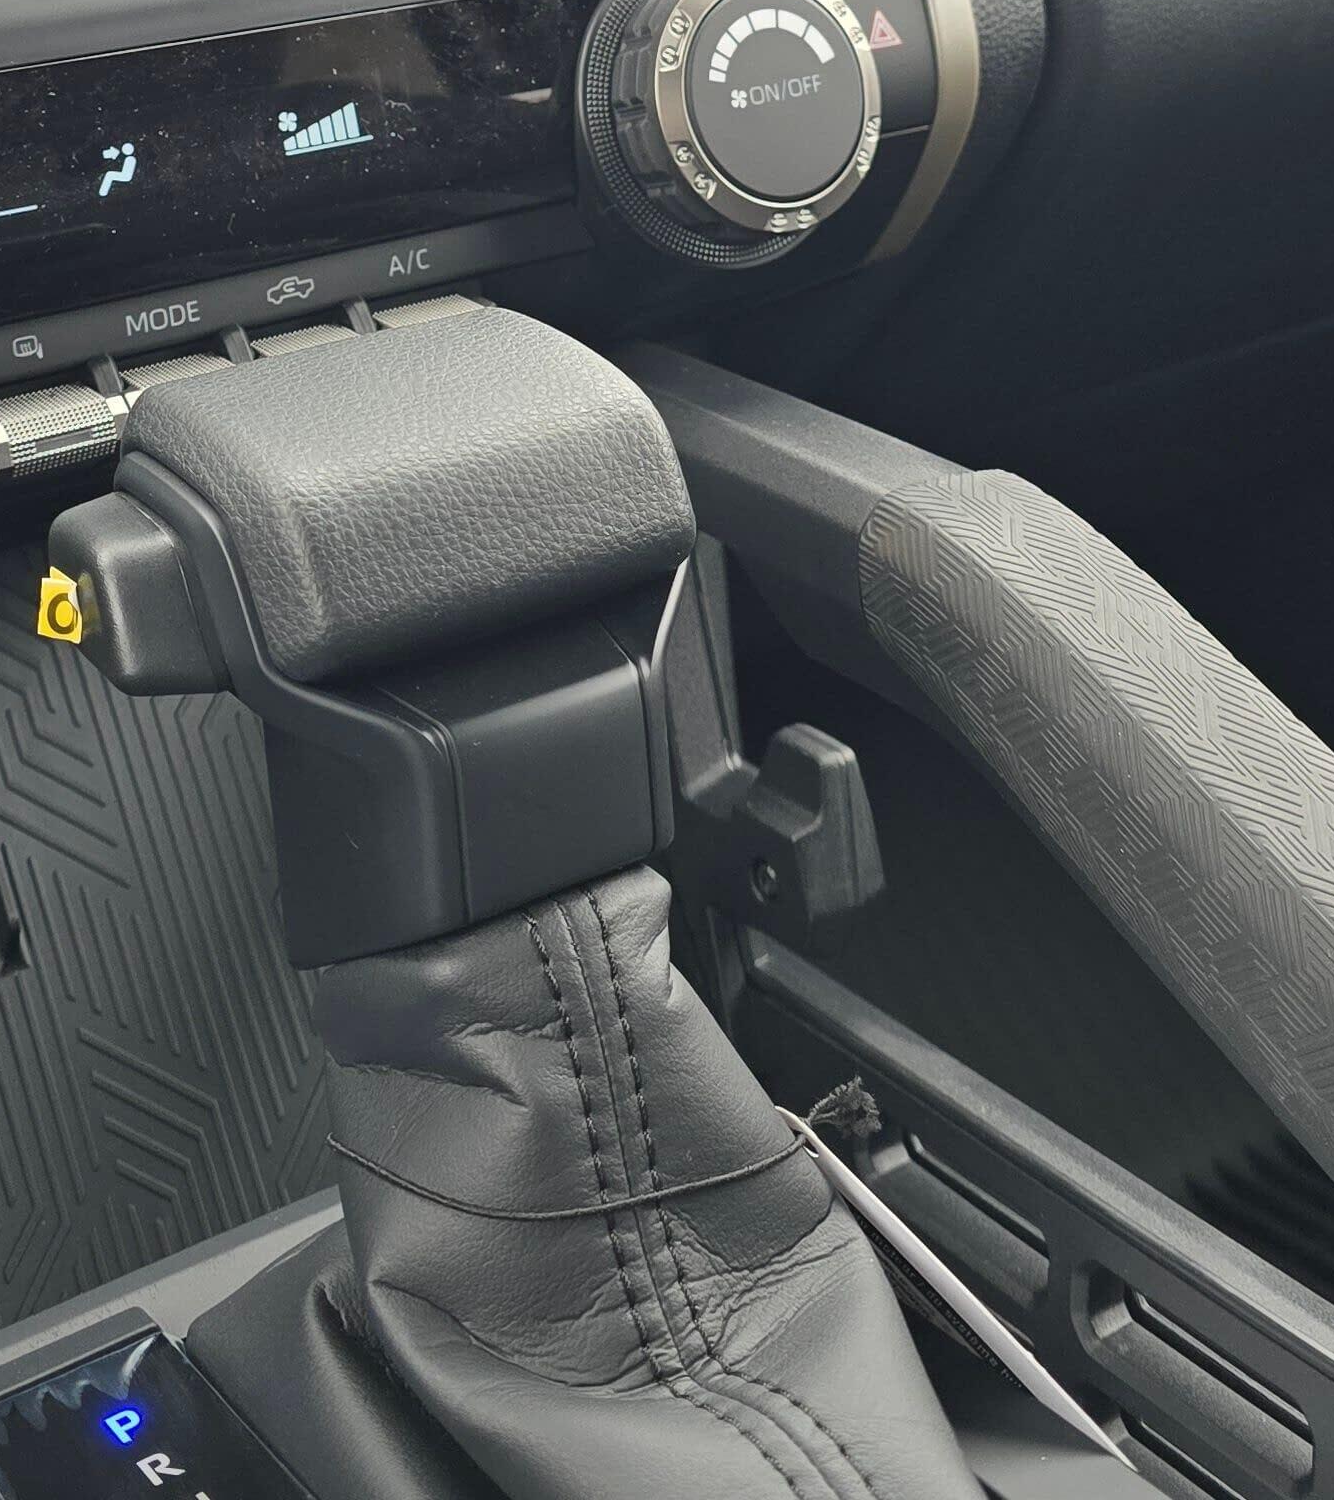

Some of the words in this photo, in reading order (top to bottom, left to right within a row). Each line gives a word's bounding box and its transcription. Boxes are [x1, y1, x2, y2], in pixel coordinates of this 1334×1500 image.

[750, 74, 823, 106] ON/OFF
[388, 248, 431, 277] A/C
[125, 300, 201, 336] MODE
[104, 1410, 140, 1443] P
[136, 1453, 185, 1486] R
